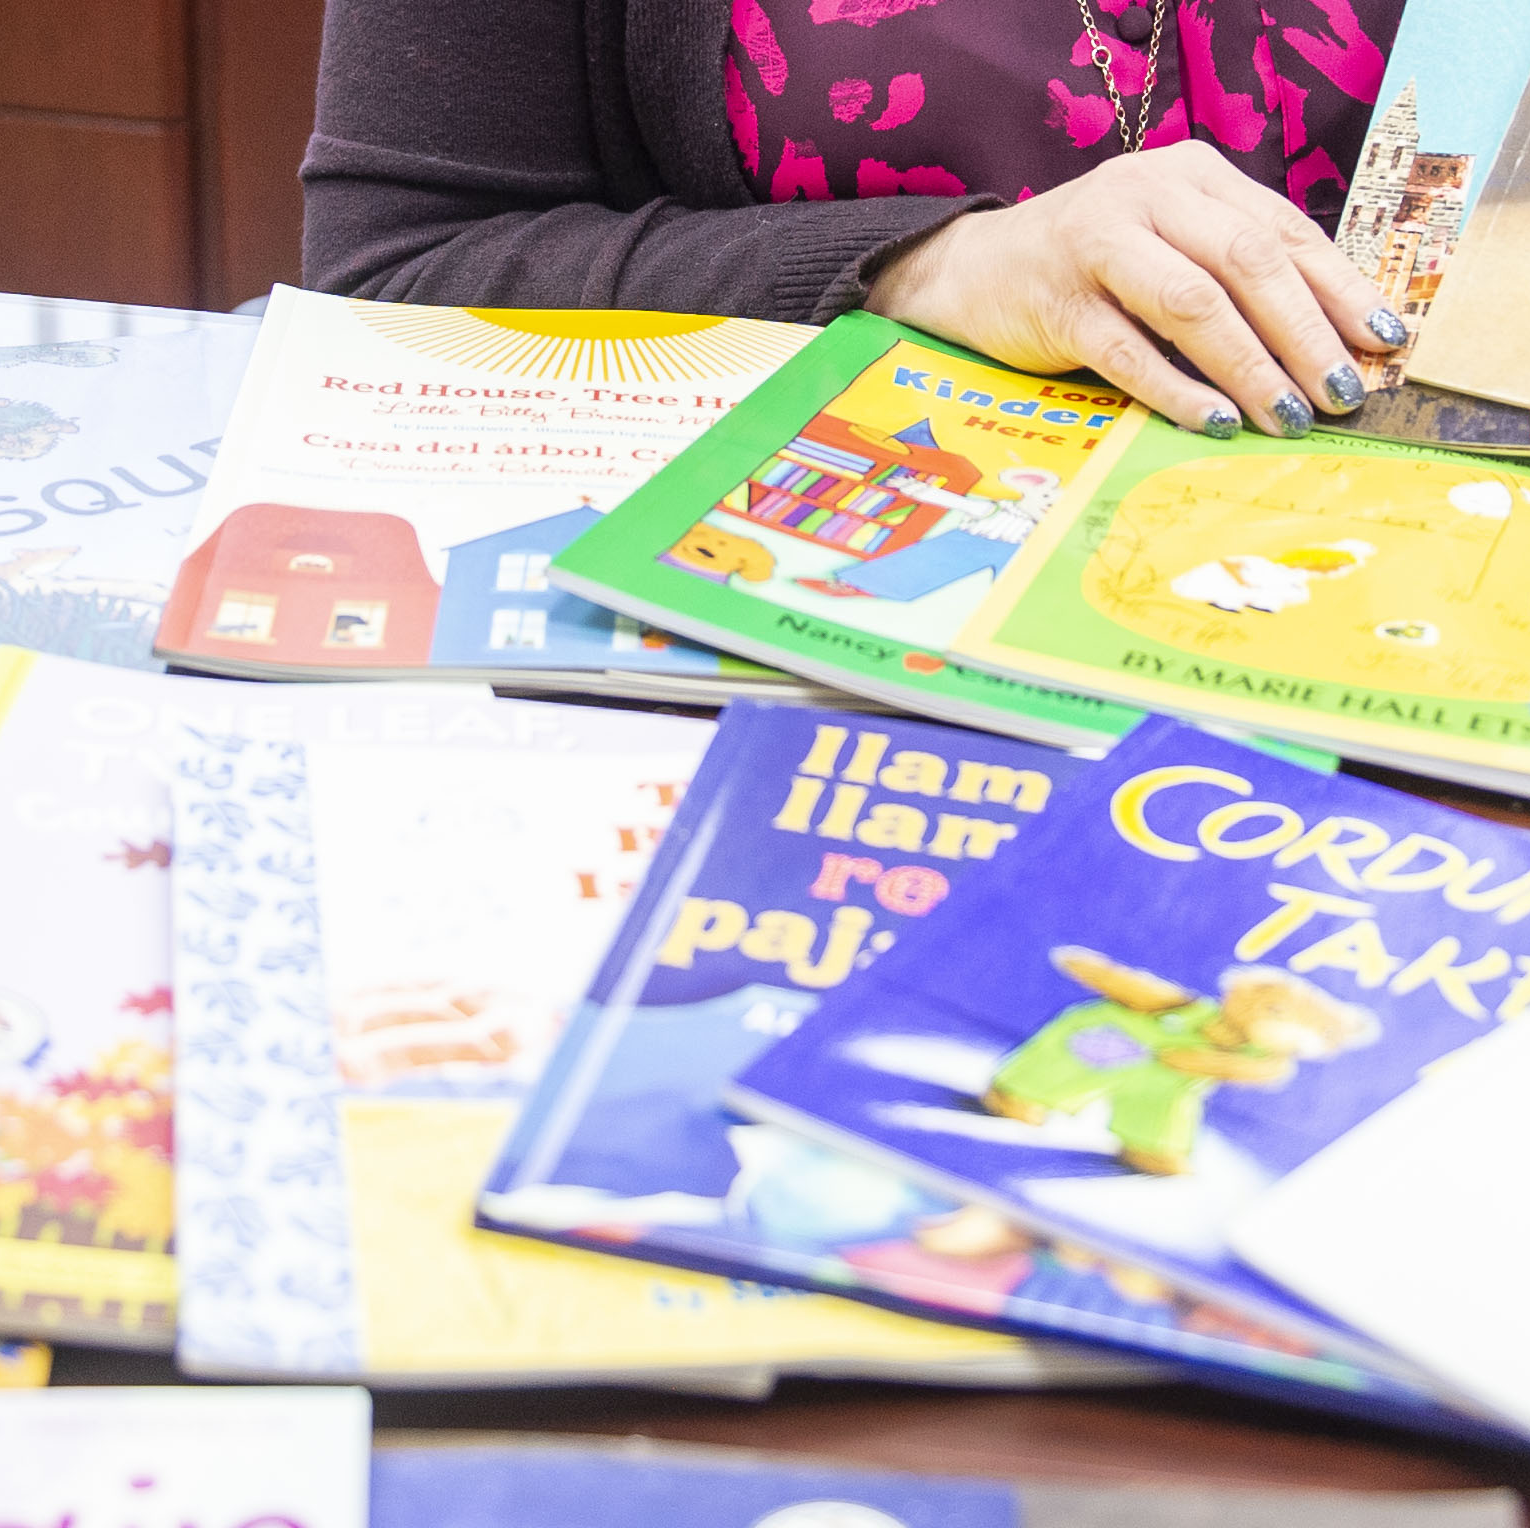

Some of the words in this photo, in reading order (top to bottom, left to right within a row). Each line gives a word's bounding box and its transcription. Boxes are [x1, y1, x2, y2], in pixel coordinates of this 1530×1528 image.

[320, 375, 404, 396] Red
[416, 383, 570, 402] House,
[583, 388, 678, 406] Tree
[302, 432, 403, 454] Casa
[415, 441, 482, 455] del
[492, 441, 617, 461] árbol,
[963, 415, 1067, 446] Here
[776, 613, 898, 663] Nancy
[1121, 648, 1177, 675] BY
[1183, 665, 1318, 705] MARIE
[1338, 691, 1457, 730] HALL
[655, 894, 897, 990] paj
